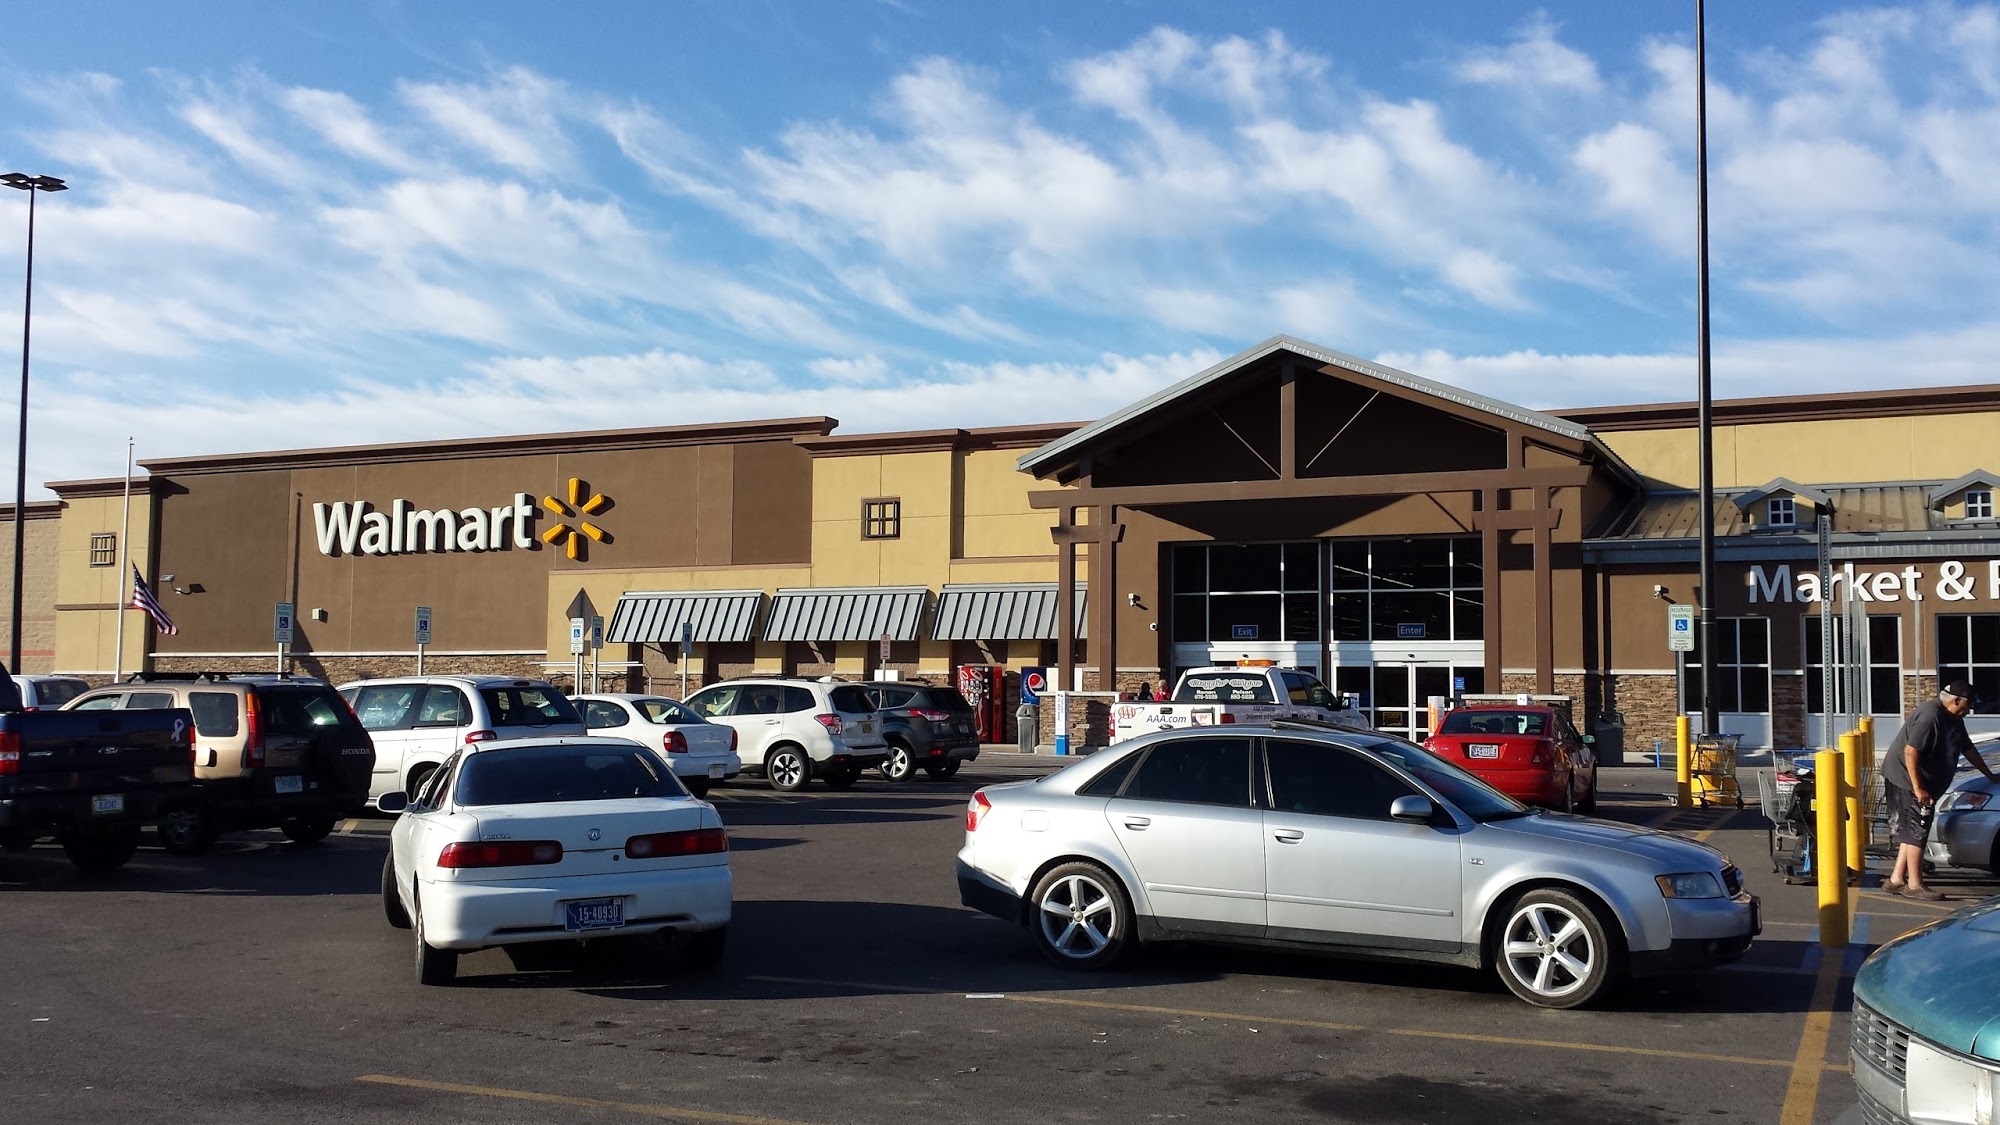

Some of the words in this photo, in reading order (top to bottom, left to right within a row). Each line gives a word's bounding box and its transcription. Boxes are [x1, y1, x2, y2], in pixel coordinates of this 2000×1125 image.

[313, 493, 533, 555] Walmart
[1749, 561, 1923, 603] Market
[1936, 560, 1976, 601] &
[1238, 628, 1253, 636] Exit
[1400, 626, 1423, 635] Enter
[1146, 714, 1187, 724] AAA.com
